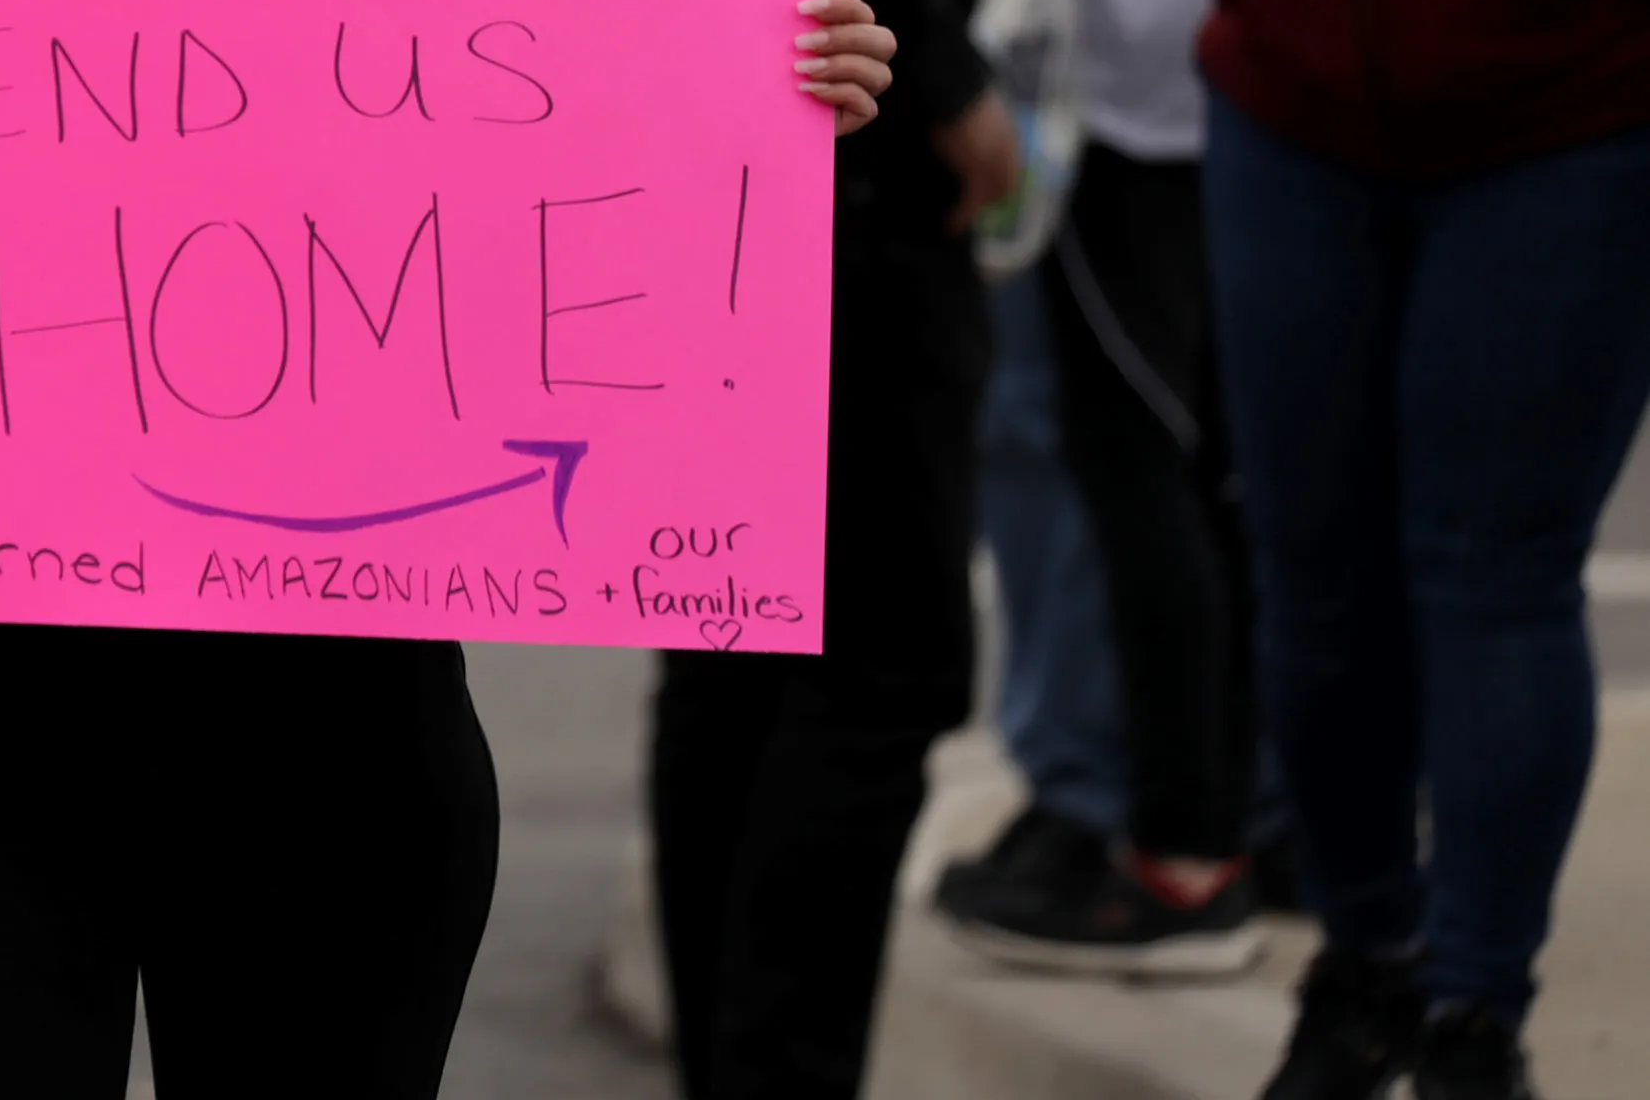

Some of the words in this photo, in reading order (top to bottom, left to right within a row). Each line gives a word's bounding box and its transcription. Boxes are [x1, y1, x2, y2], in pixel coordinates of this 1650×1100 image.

[649, 522, 752, 561] our
[197, 548, 569, 618] AMAZONIANS
[631, 564, 805, 621] families
